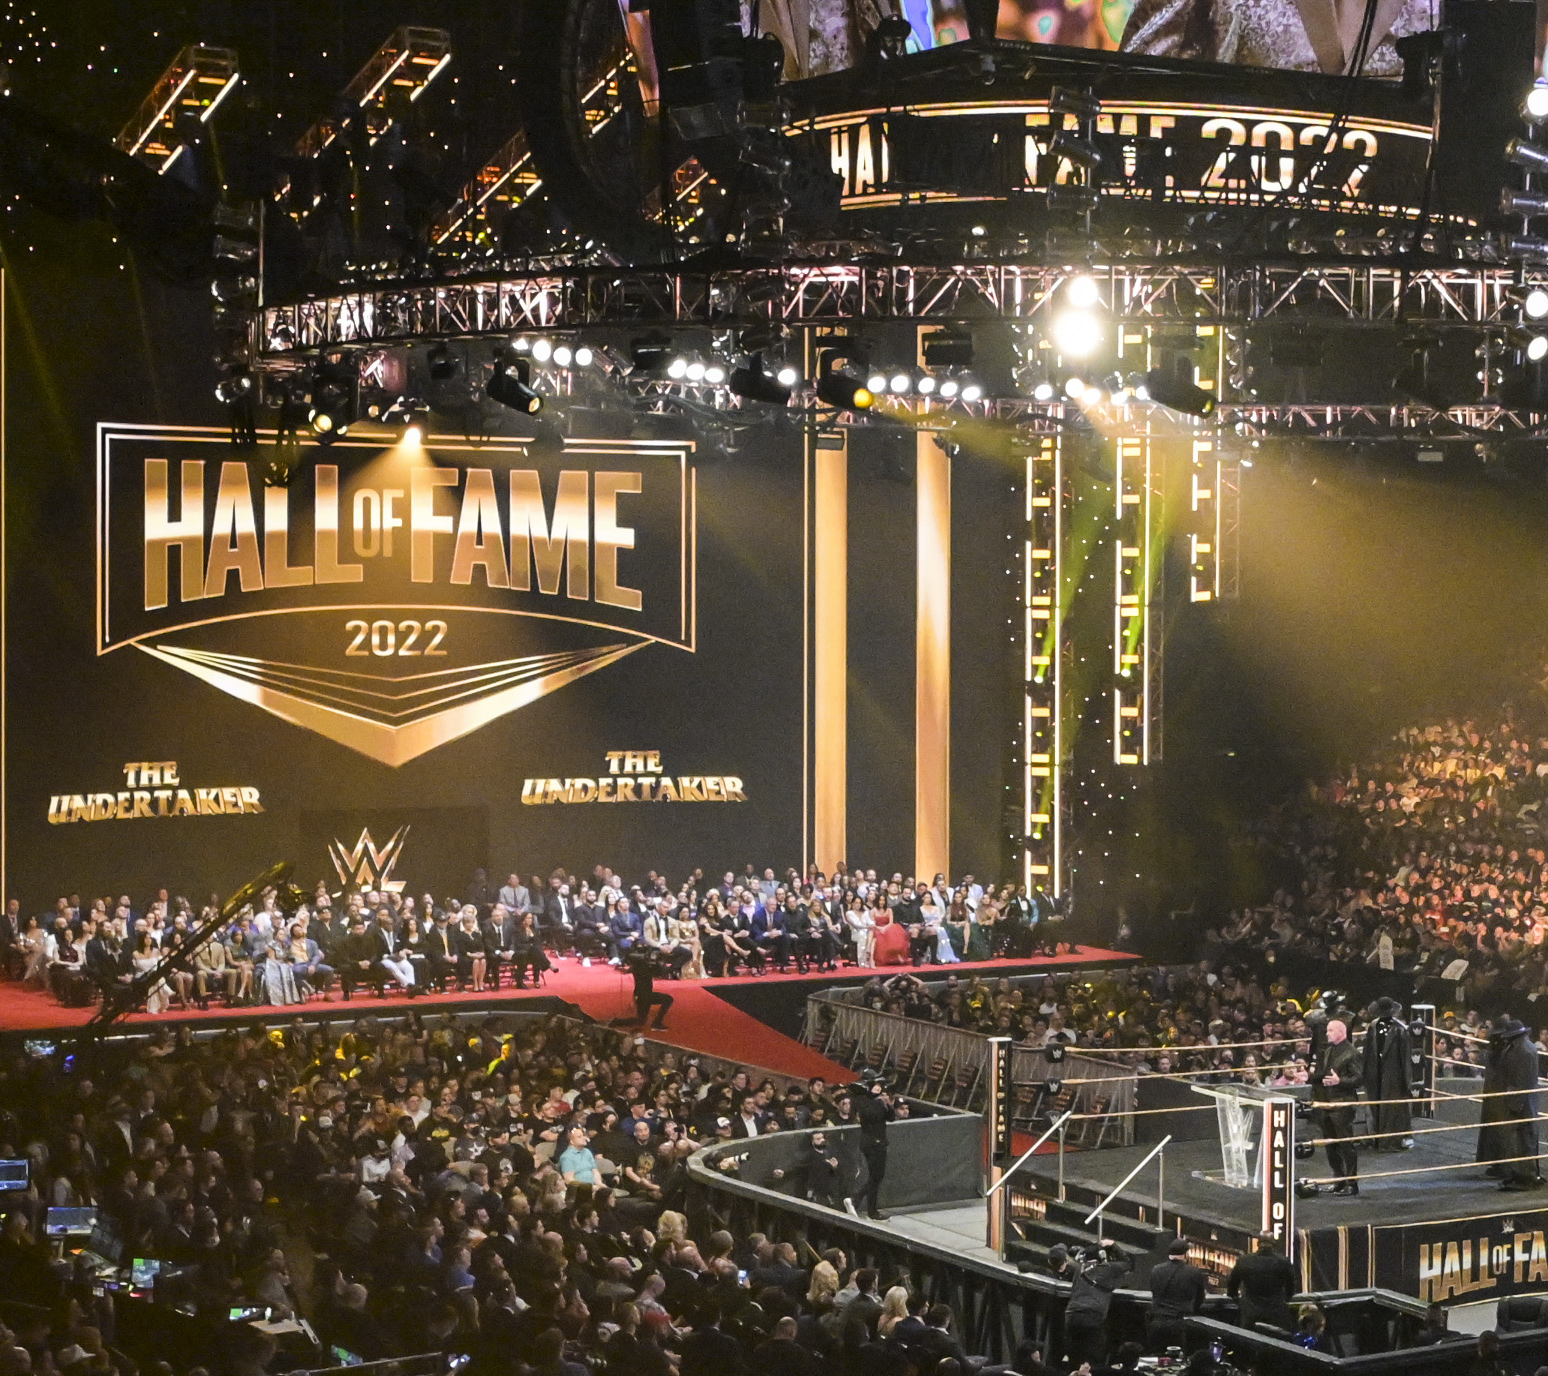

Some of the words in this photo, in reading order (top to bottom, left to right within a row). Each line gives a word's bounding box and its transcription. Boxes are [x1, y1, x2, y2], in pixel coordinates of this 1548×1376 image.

[144, 458, 363, 611] HALL
[353, 489, 403, 559] OF
[410, 467, 642, 611] FAME
[345, 620, 448, 656] 2022
[123, 760, 180, 788] THE
[604, 750, 663, 774] THE
[48, 785, 266, 824] UNDERTAKER
[521, 775, 749, 805] UNDERTAKER
[1273, 1110, 1286, 1188] HALL
[1272, 1202, 1285, 1240] OF
[1419, 1237, 1497, 1303] HALL
[1492, 1244, 1512, 1275] OF
